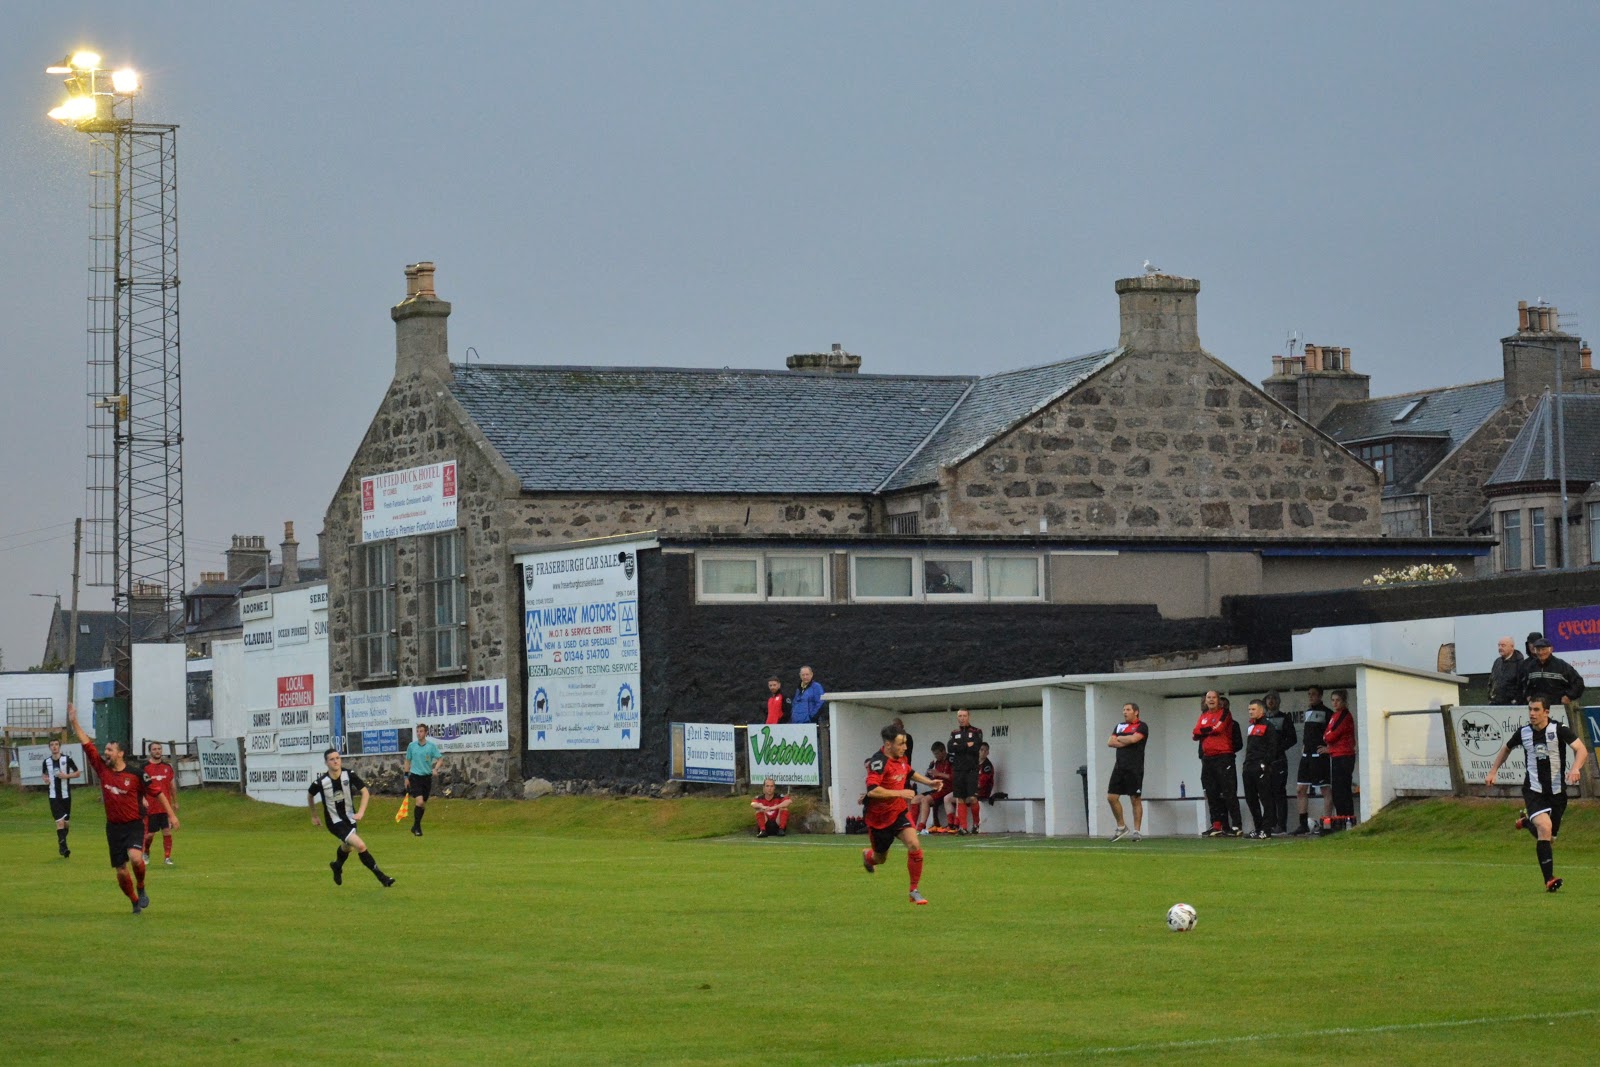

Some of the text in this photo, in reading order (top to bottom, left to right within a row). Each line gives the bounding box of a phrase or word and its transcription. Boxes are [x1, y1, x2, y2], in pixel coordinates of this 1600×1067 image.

[376, 466, 440, 488] TUFTED DUCK HOTEL
[372, 530, 384, 539] North
[386, 528, 399, 537] East's
[400, 524, 415, 534] Premier
[416, 521, 435, 532] Function
[436, 518, 456, 528] Location
[536, 558, 584, 576] FRASERBURGH
[586, 557, 599, 570] CAR
[544, 602, 617, 626] MURRAY MOTORS
[278, 629, 290, 638] OCEAN
[571, 627, 591, 636] SERVICE
[593, 626, 612, 635] CENTRE
[244, 631, 272, 646] CLAUDIA
[544, 641, 556, 650] NEW
[564, 640, 577, 649] USED
[579, 639, 589, 647] CAR
[591, 637, 618, 647] SPECIALIST
[564, 649, 610, 661] 01346 514700
[622, 650, 638, 658] CENTRE
[530, 663, 638, 676] BOSCH DIAGNOSTIC TESTING SERVICE
[286, 676, 304, 691] LOCAL
[280, 692, 312, 707] FISHERMEN
[413, 685, 504, 718] WATERMILL
[253, 713, 270, 727] SUNRISE
[281, 710, 309, 726] OCEAN DAWN
[614, 712, 639, 721] McWILLIAM
[449, 724, 453, 736] &
[454, 720, 482, 736] WEDDING
[485, 720, 503, 733] CARS
[687, 726, 733, 743] Neil Simpson
[991, 725, 1008, 737] AWAY
[252, 735, 271, 750] ARGOSY
[750, 726, 816, 765] Victoria
[202, 752, 237, 766] FRASERBURGH
[687, 747, 734, 760] Joinery Services
[204, 767, 239, 780] TRAWLERS LTD
[250, 770, 277, 783] OCEAN REAPER
[282, 770, 294, 782] OCEAN
[296, 770, 308, 782] QUEST
[751, 772, 818, 782] www.victoriacoaches.co.uk
